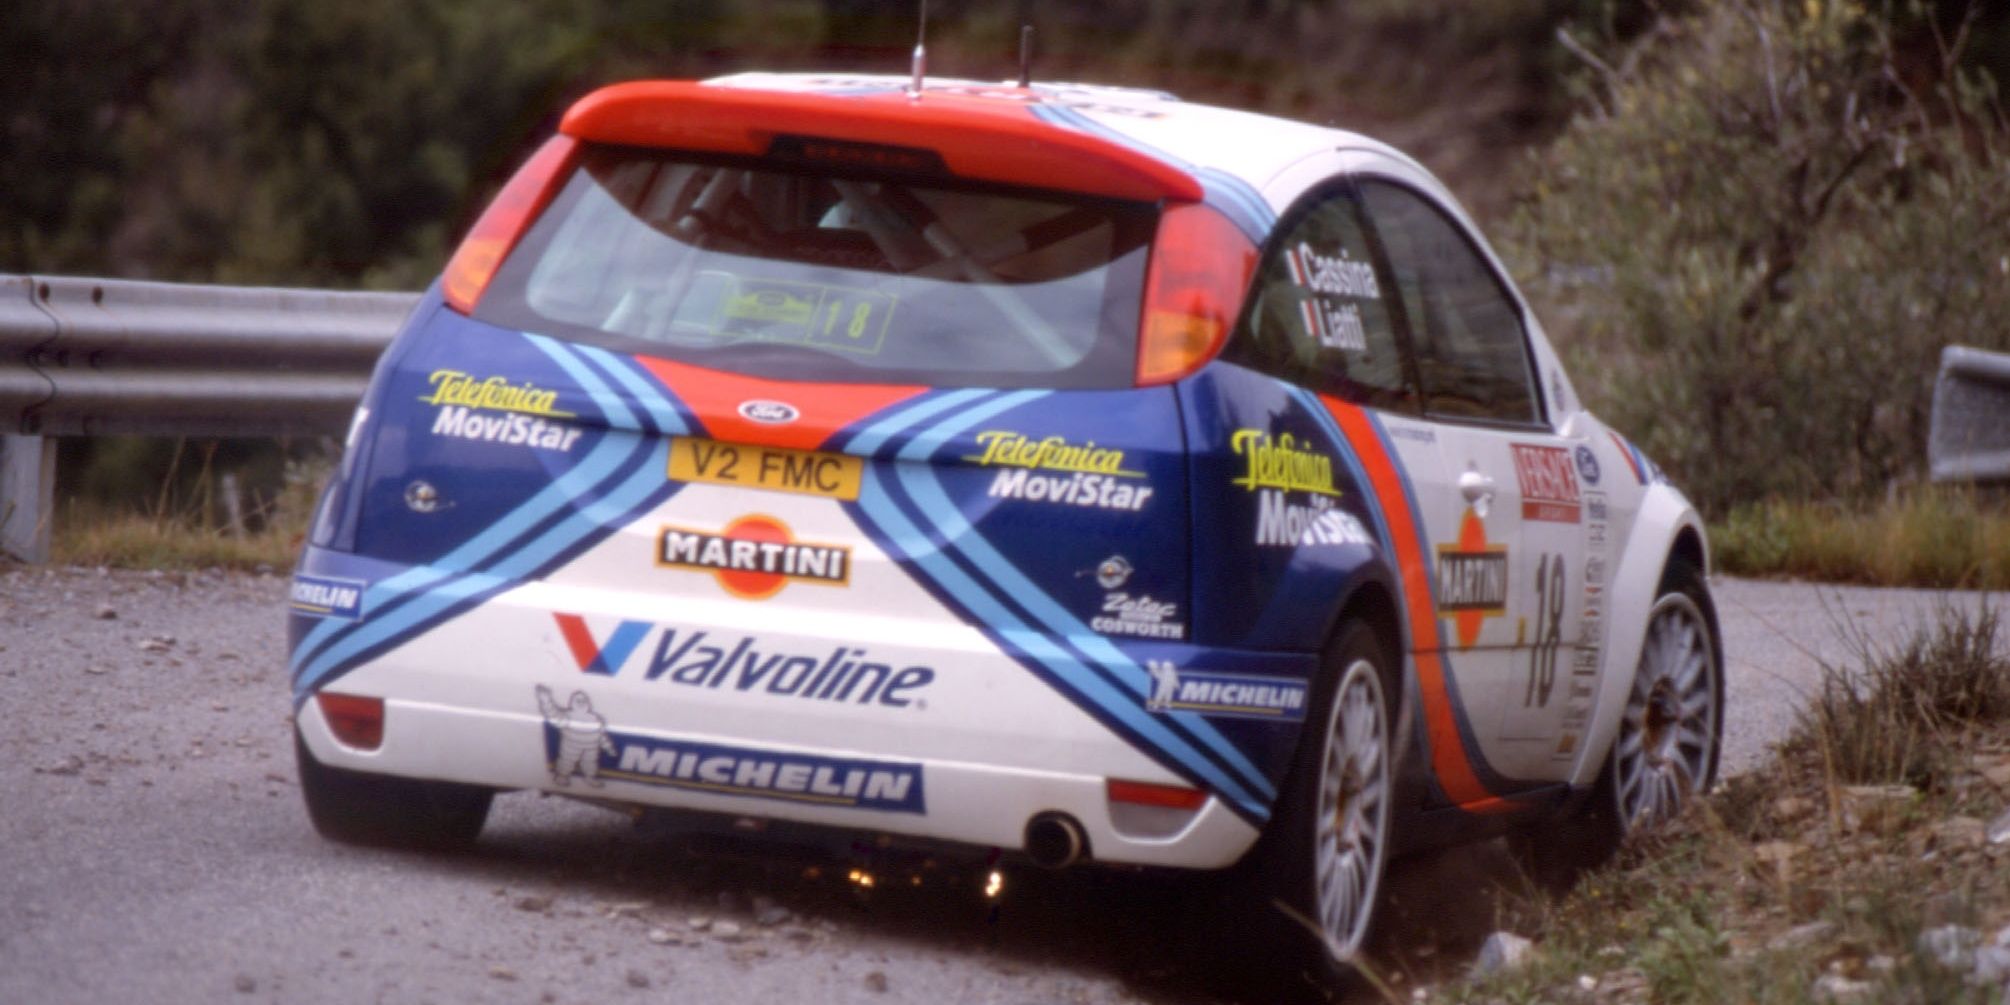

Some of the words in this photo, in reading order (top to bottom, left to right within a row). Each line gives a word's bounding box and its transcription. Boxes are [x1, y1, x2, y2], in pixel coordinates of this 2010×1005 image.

[1299, 241, 1379, 299] Cassina
[823, 301, 873, 338] 18
[1313, 298, 1366, 350] Liatti
[431, 405, 583, 452] MoviStar
[690, 442, 741, 481] V2
[757, 450, 843, 493] FMC
[987, 468, 1154, 511] MoviStar
[663, 530, 846, 580] MARTINI
[291, 581, 359, 610] CHELIN
[1090, 615, 1185, 640] COSWORTH
[1525, 552, 1566, 709] 18
[643, 627, 936, 709] Valvoline
[1179, 680, 1304, 710] MICHELIN
[617, 743, 913, 801] MICHELIN
